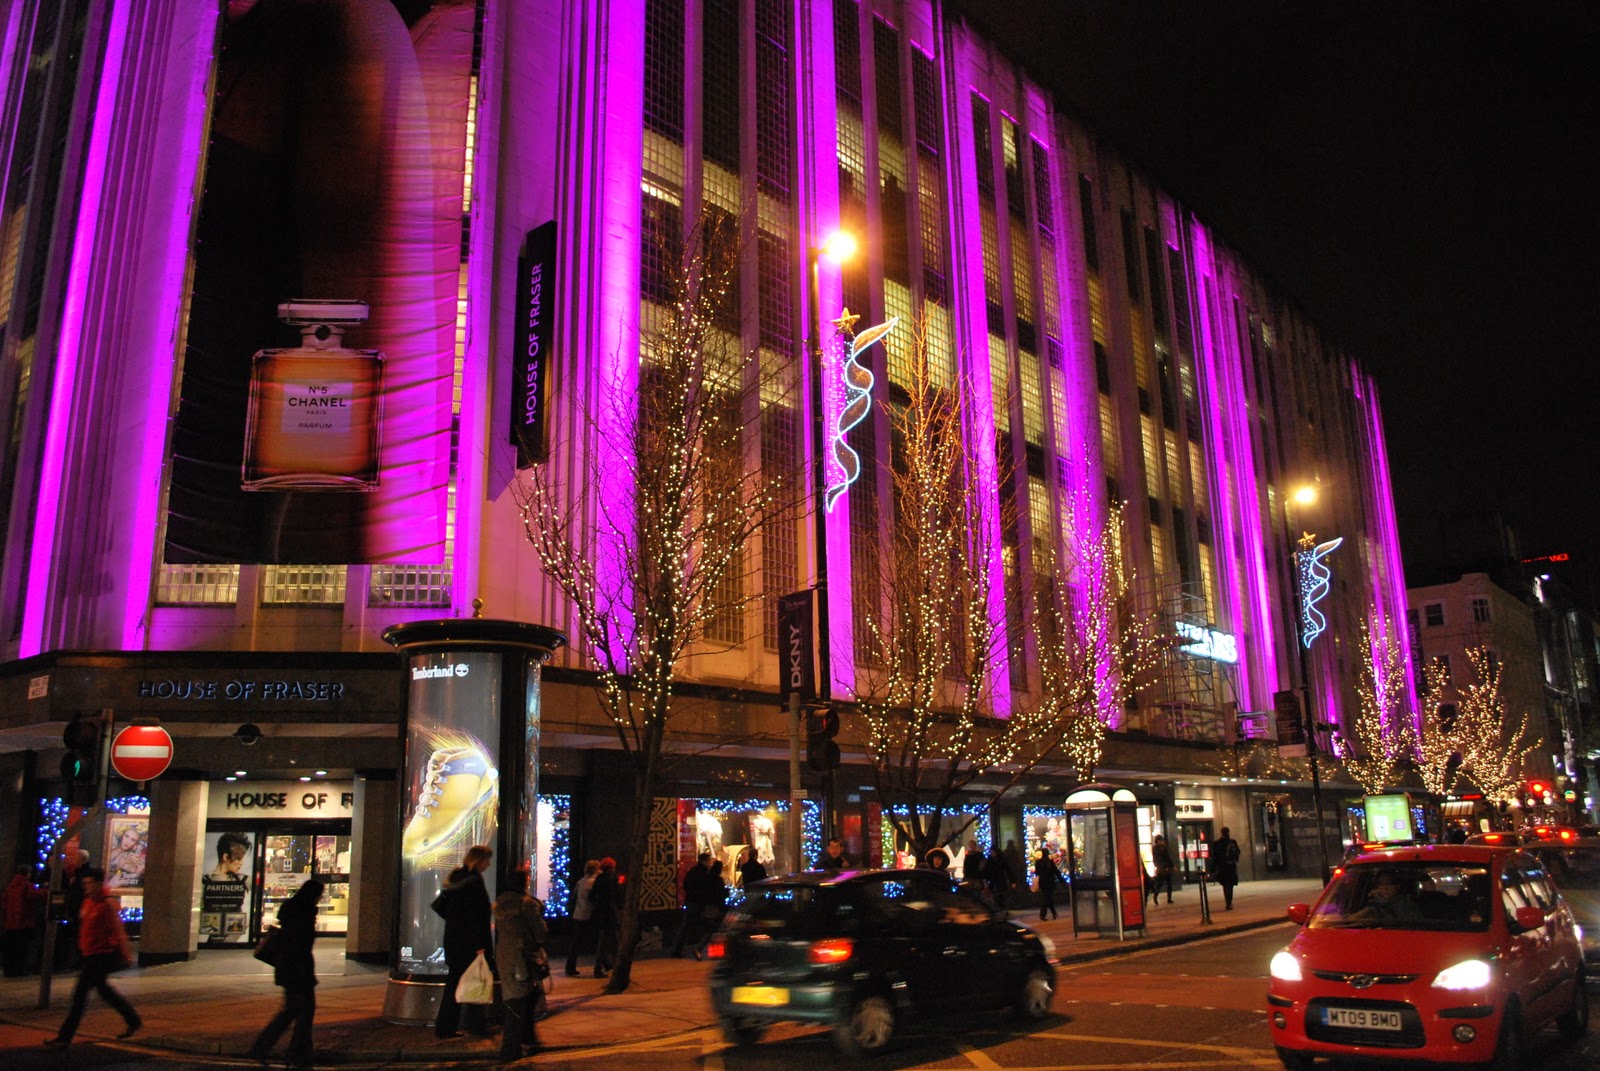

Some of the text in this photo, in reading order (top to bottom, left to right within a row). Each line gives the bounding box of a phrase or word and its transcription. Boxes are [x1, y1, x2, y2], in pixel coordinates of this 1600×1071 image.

[525, 262, 543, 425] HOUSE OF FRASER
[288, 397, 347, 408] CHANEL
[789, 624, 801, 688] DKNY
[412, 664, 454, 680] Timberland
[138, 680, 345, 700] HOUSE OF FRASER
[226, 792, 288, 809] HOUSE
[301, 792, 328, 809] OF
[1329, 1010, 1398, 1027] MT09 BMO
